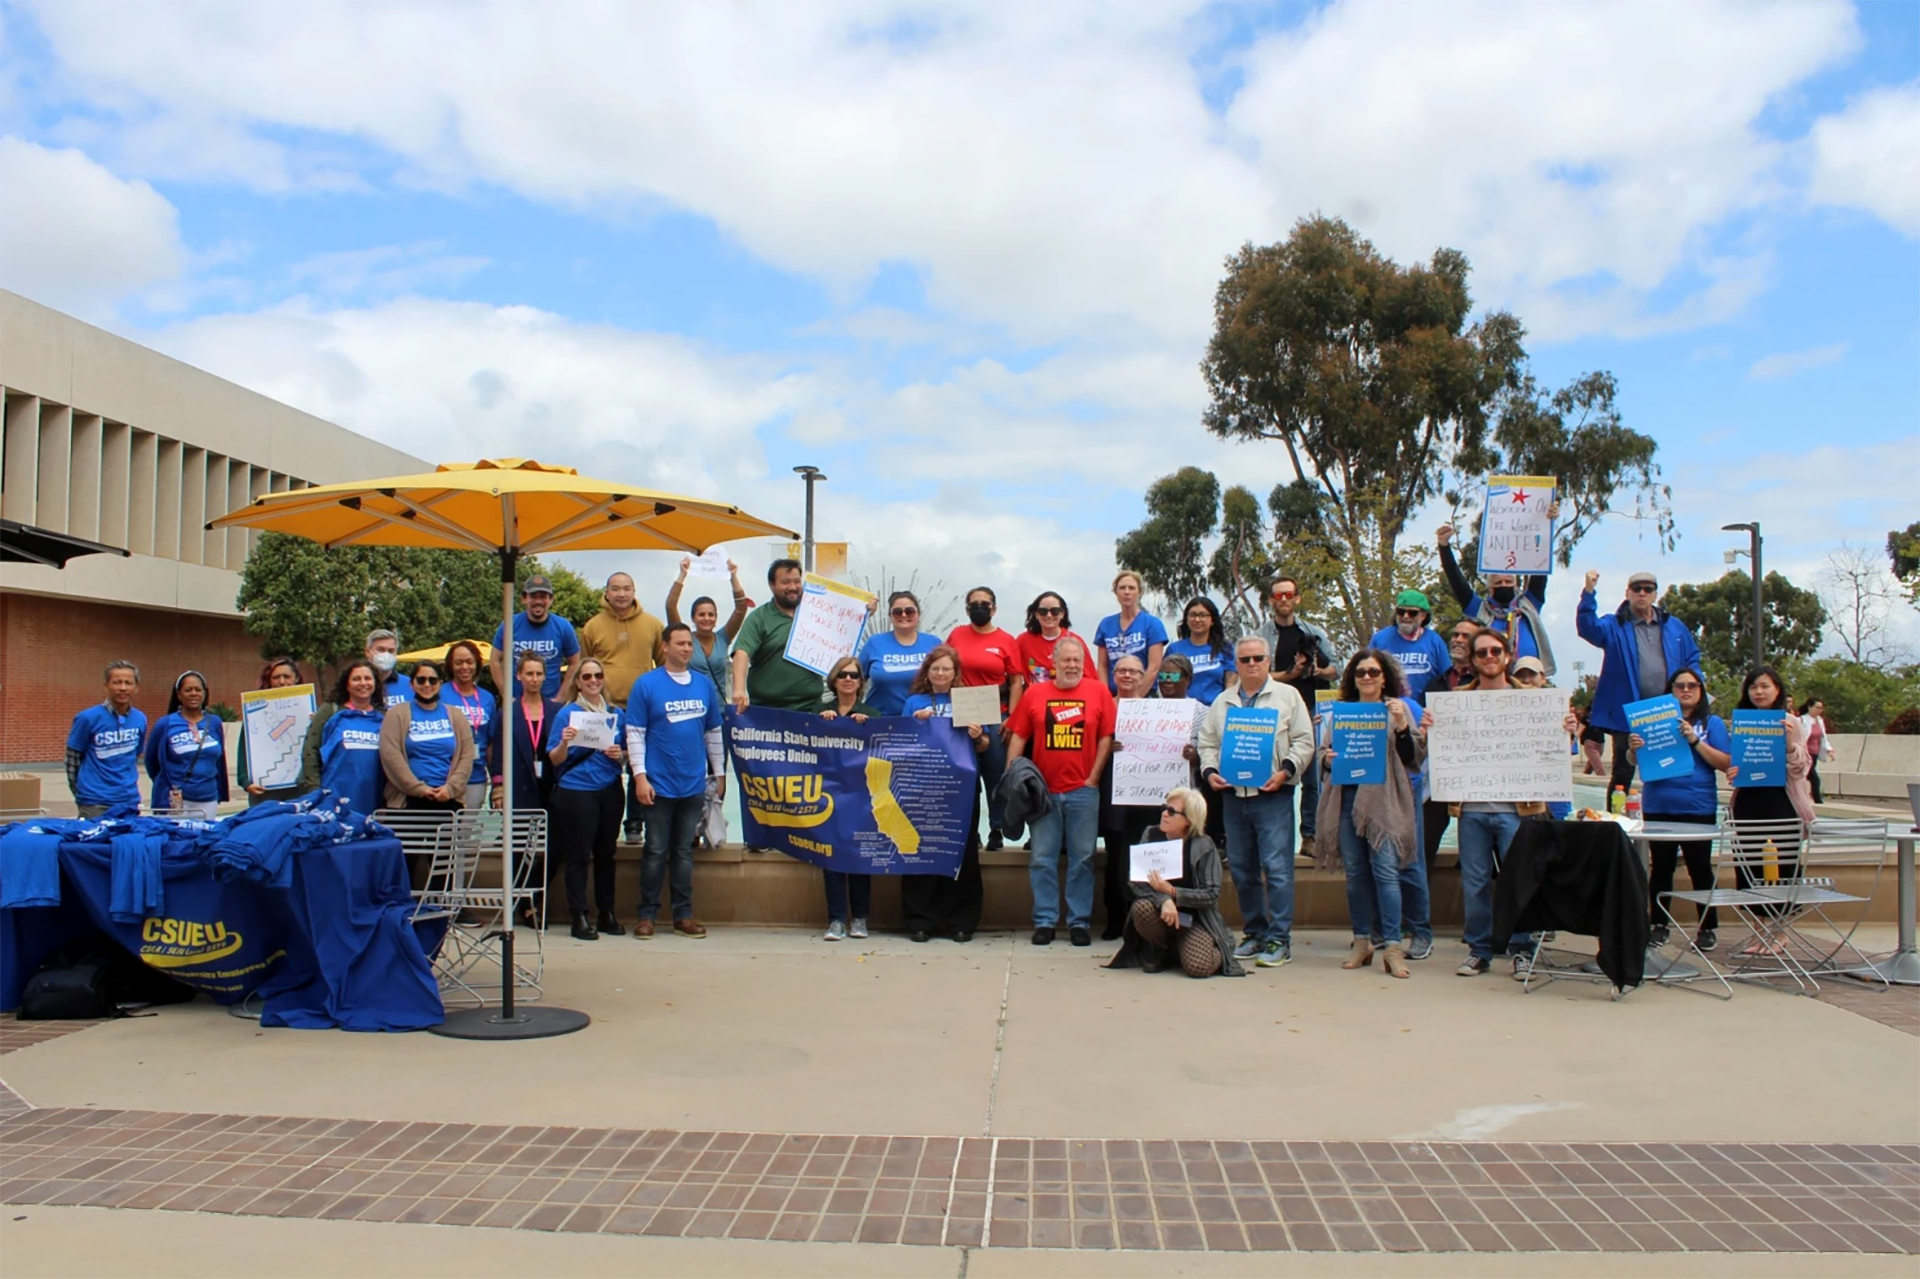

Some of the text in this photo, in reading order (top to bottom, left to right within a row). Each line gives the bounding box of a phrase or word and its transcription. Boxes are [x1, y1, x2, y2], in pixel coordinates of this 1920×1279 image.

[1490, 518, 1540, 532] THE WORLD
[1484, 534, 1541, 553] UNITE!
[803, 593, 838, 615] LABOR
[810, 611, 833, 629] MAKE
[512, 640, 555, 652] CSUEU
[883, 653, 927, 663] CSUEU
[665, 699, 703, 711] CSUEU
[1123, 700, 1183, 715] JOE HILL
[1433, 695, 1491, 715] CSULB
[1495, 695, 1553, 711] STUDENT
[1334, 721, 1386, 730] APPRECIATED
[1436, 711, 1566, 728] STAFF PROTEST AGAINST
[1631, 710, 1678, 728] APPRECIATED
[1053, 724, 1071, 735] BUT
[1117, 719, 1151, 733] HARRY
[1226, 724, 1274, 734] APPRECIATED
[1642, 722, 1672, 734] will always
[1734, 727, 1784, 736] APPRECIATED
[94, 728, 140, 746] CSUEU
[731, 727, 865, 751] California State University
[1047, 734, 1081, 748] I WILL
[1434, 730, 1471, 741] CSULB
[1474, 728, 1523, 740] PRESIDENT
[1661, 734, 1674, 742] what
[1122, 743, 1141, 753] IGHT
[1441, 744, 1452, 752] ON
[1496, 742, 1507, 750] AT
[1547, 740, 1560, 750] BY
[1652, 740, 1677, 750] expected
[1754, 738, 1774, 746] always
[733, 744, 818, 764] Employees Union
[1436, 754, 1454, 765] THE
[1457, 754, 1487, 763] WATER
[1115, 762, 1183, 774] FIGHT FOR PAY
[741, 773, 823, 804] CSUEU
[1436, 775, 1468, 793] FREE
[1470, 774, 1500, 787] HUGS
[1508, 773, 1531, 785] HIGH
[1115, 786, 1126, 797] BE
[788, 834, 833, 857] csueu.org
[142, 917, 227, 946] CSUEU
[166, 947, 185, 955] SEIU
